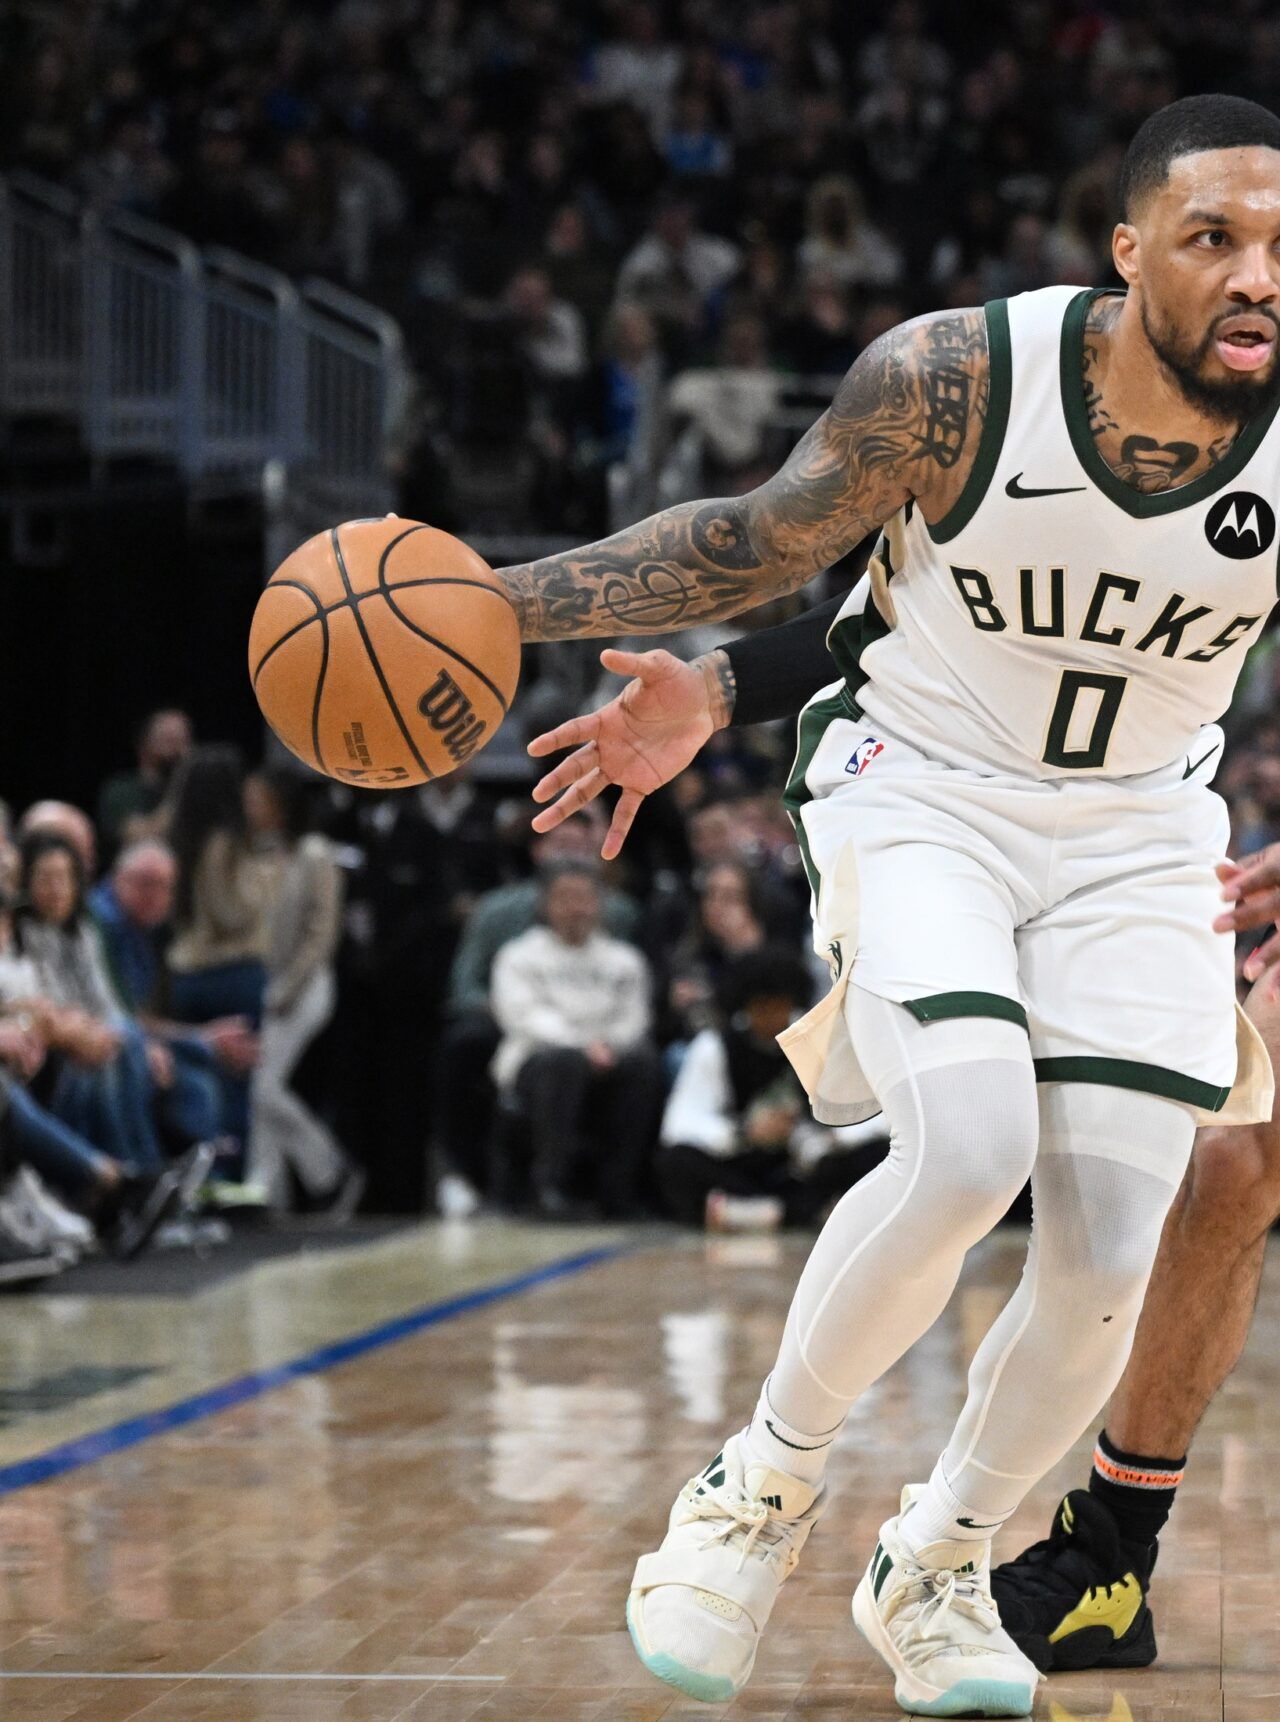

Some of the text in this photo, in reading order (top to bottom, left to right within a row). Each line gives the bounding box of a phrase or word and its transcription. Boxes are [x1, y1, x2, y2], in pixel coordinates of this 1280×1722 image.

[949, 564, 1266, 663] BUCKS
[417, 667, 487, 763] Wils
[1041, 665, 1132, 769] 0
